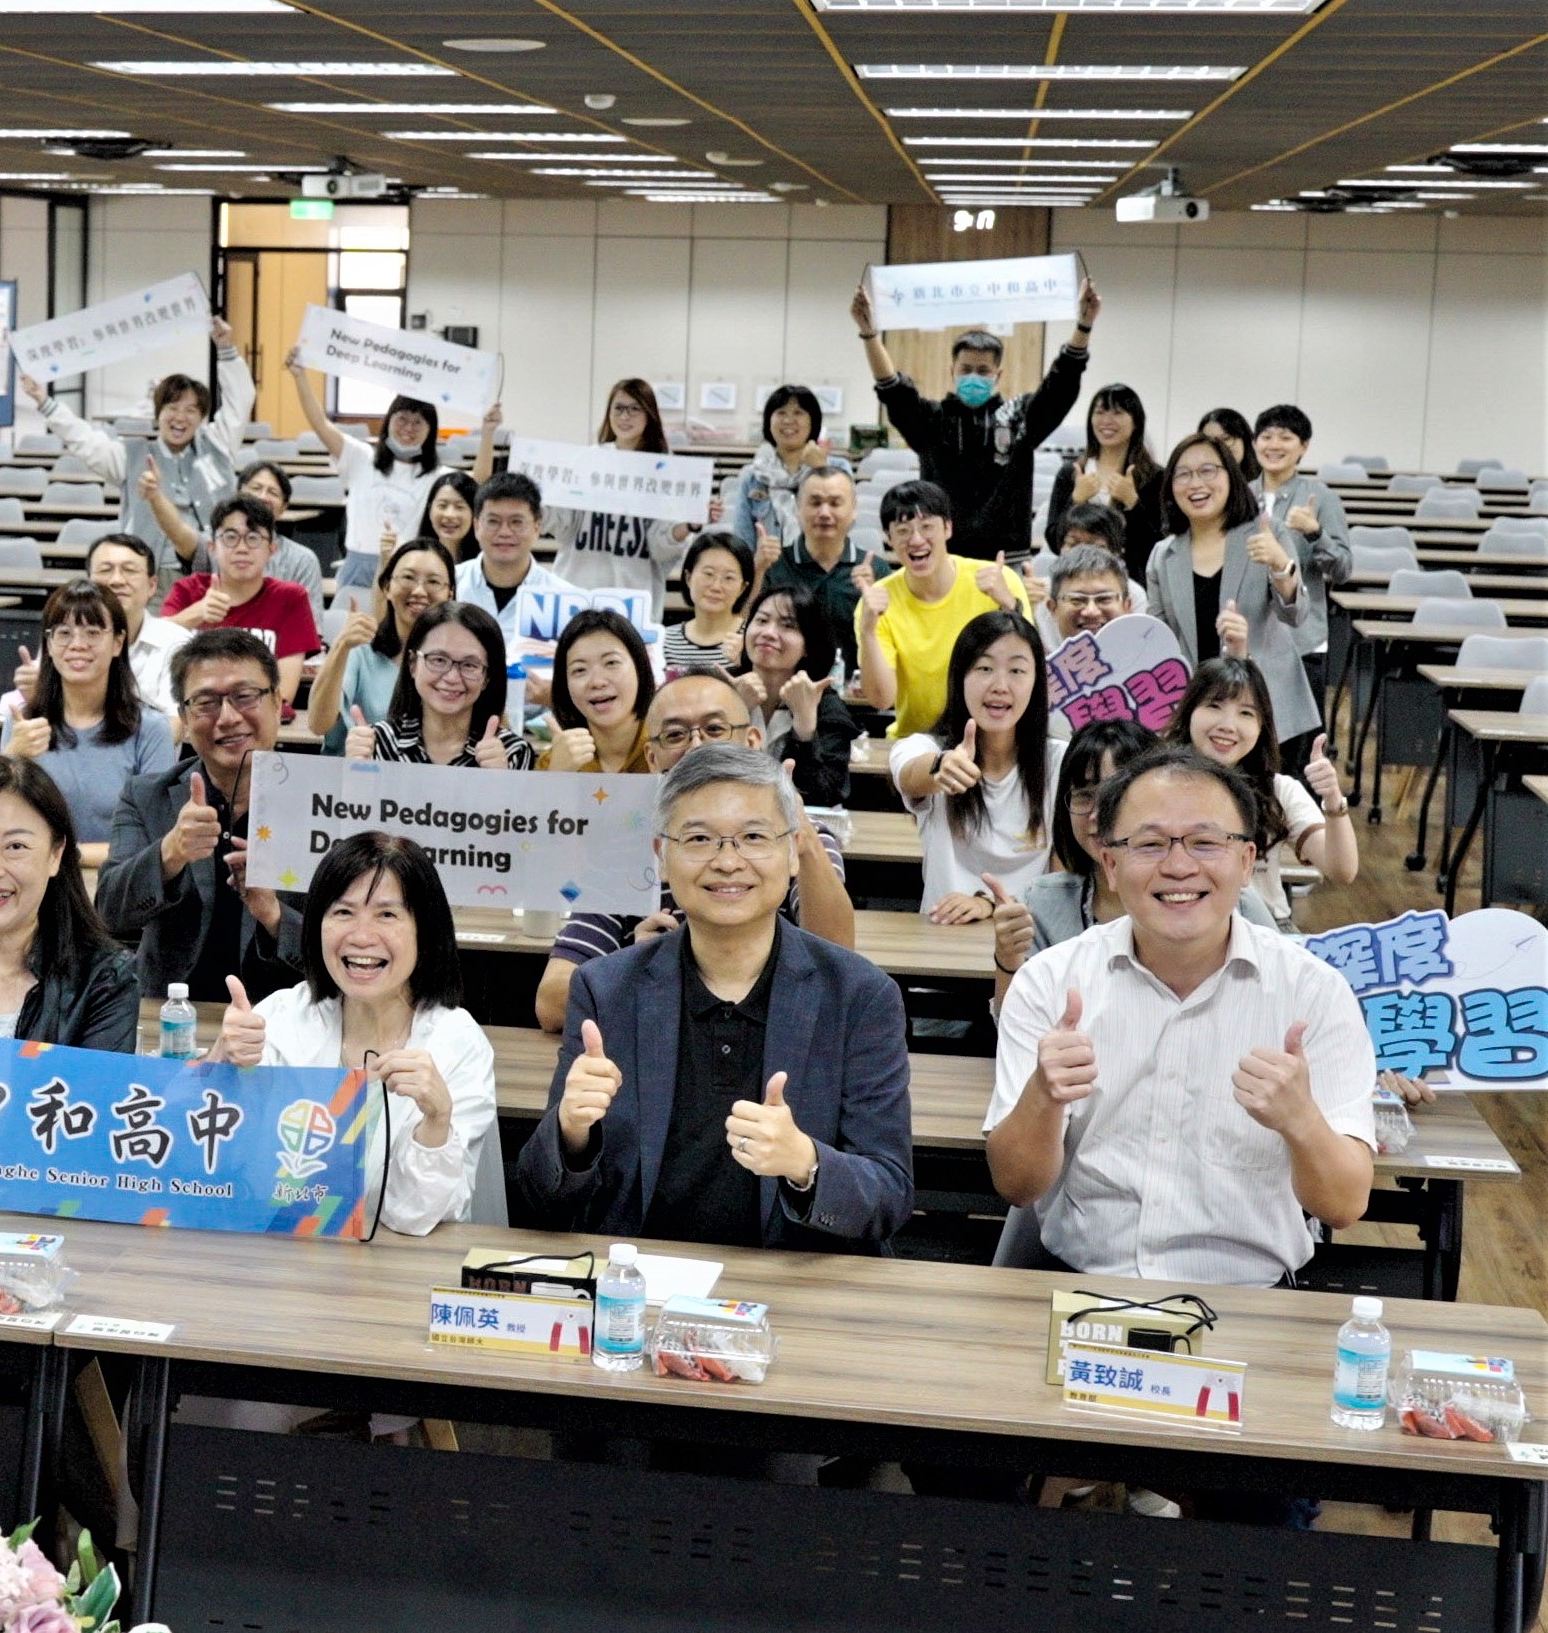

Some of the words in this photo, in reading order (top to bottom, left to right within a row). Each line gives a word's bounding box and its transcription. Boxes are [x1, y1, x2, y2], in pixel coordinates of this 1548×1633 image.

[326, 344, 359, 364] Deep
[364, 354, 422, 382] Learning
[331, 328, 360, 345] New
[363, 337, 438, 369] Pedagogies
[442, 360, 461, 374] for
[312, 793, 371, 820] New
[380, 799, 538, 835] Pedagogies
[547, 810, 588, 835] for
[1360, 988, 1548, 1081] 學習
[47, 1168, 108, 1187] Senior
[117, 1175, 162, 1193] High
[171, 1180, 234, 1197] School
[274, 1183, 328, 1203] 新北市
[431, 1303, 500, 1331] 陳佩英
[1069, 1360, 1144, 1392] 黃致誠
